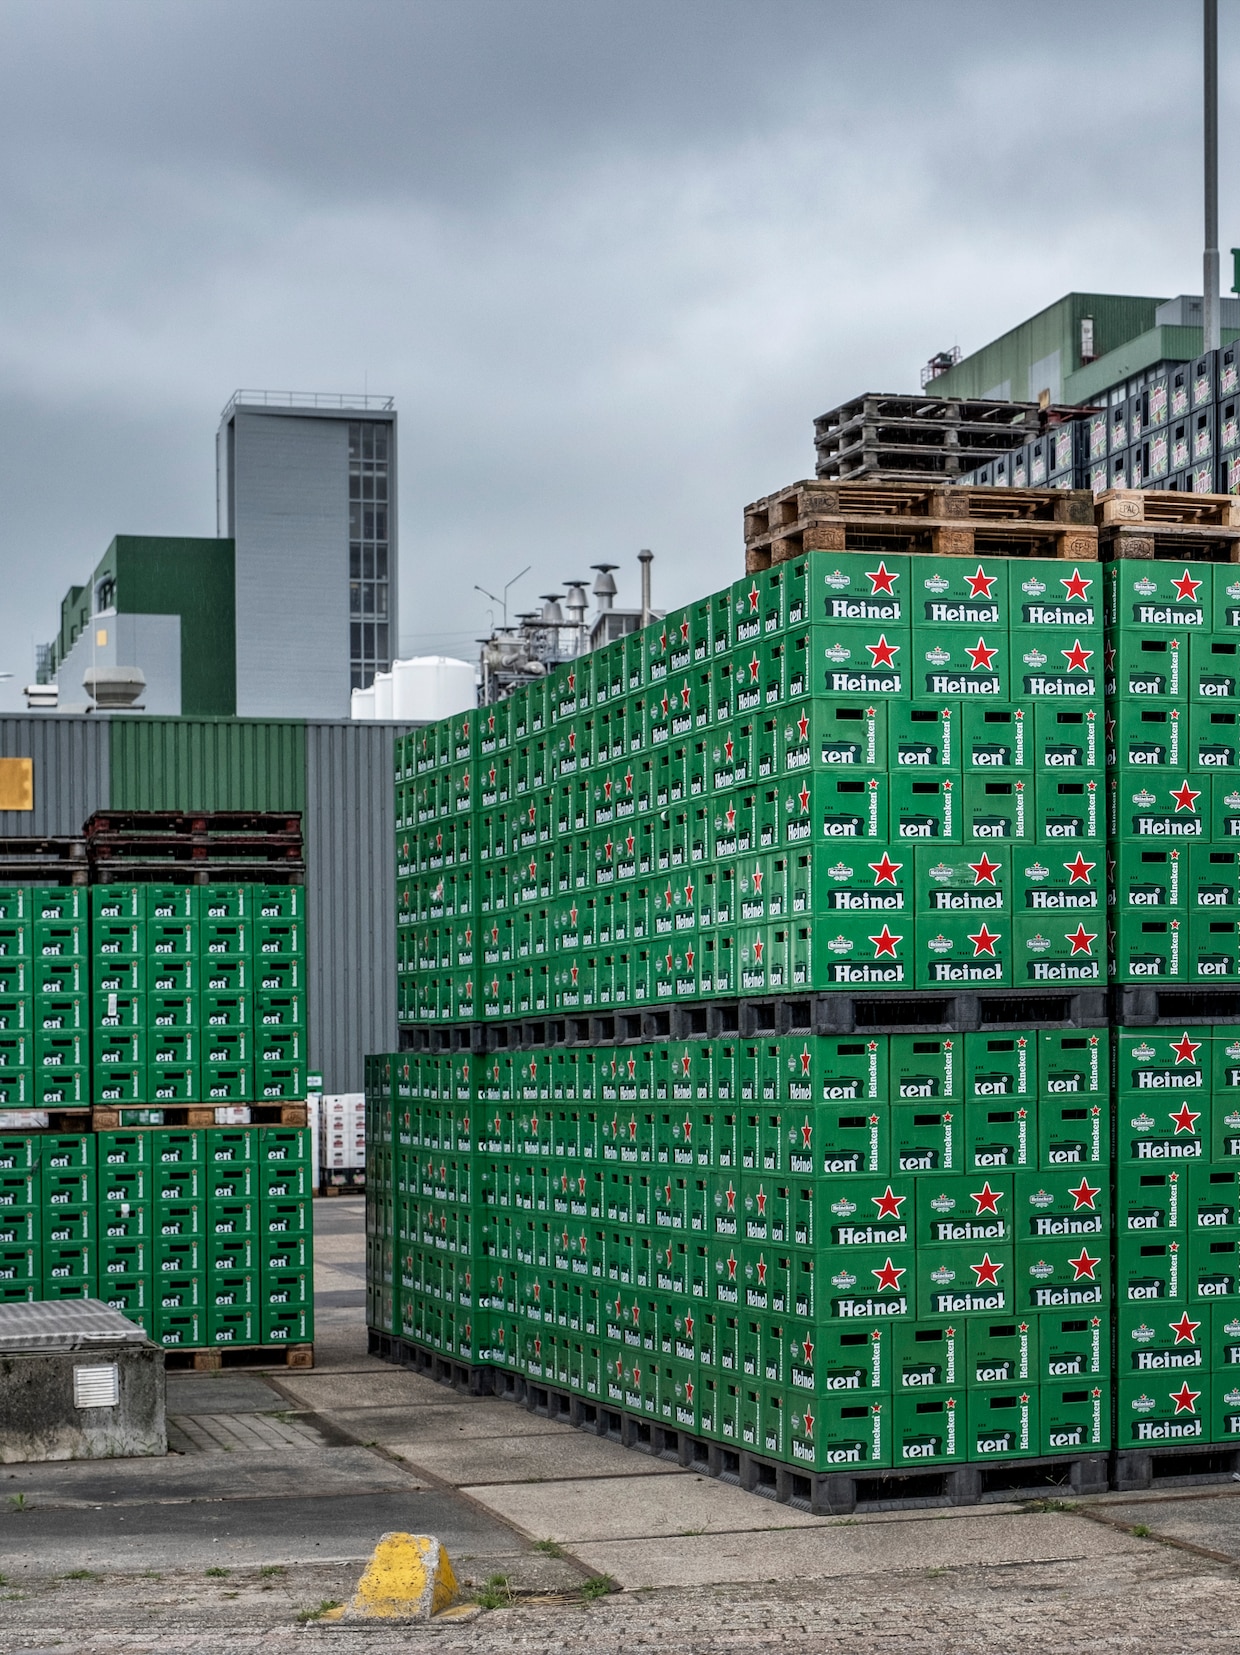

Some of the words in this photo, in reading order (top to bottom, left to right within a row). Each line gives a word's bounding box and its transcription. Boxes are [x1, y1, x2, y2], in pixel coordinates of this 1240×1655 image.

[1170, 652, 1180, 695] Heineken
[867, 720, 876, 764] Heineken
[1015, 722, 1025, 765] Heineken
[1170, 722, 1180, 765] Heineken
[868, 792, 879, 836] Heineken
[1015, 794, 1025, 837] Heineken
[1170, 863, 1180, 905] Heineken
[1171, 933, 1180, 975] Heineken
[868, 1054, 879, 1098] Heineken
[1017, 1051, 1028, 1093] Heineken
[869, 1127, 880, 1171] Heineken
[1017, 1121, 1028, 1164] Heineken
[1169, 1185, 1179, 1227] Heineken
[945, 1340, 956, 1383] Heineken
[1091, 1330, 1101, 1372] Heineken
[1020, 1406, 1030, 1449] Heineken
[1092, 1400, 1102, 1443] Heineken
